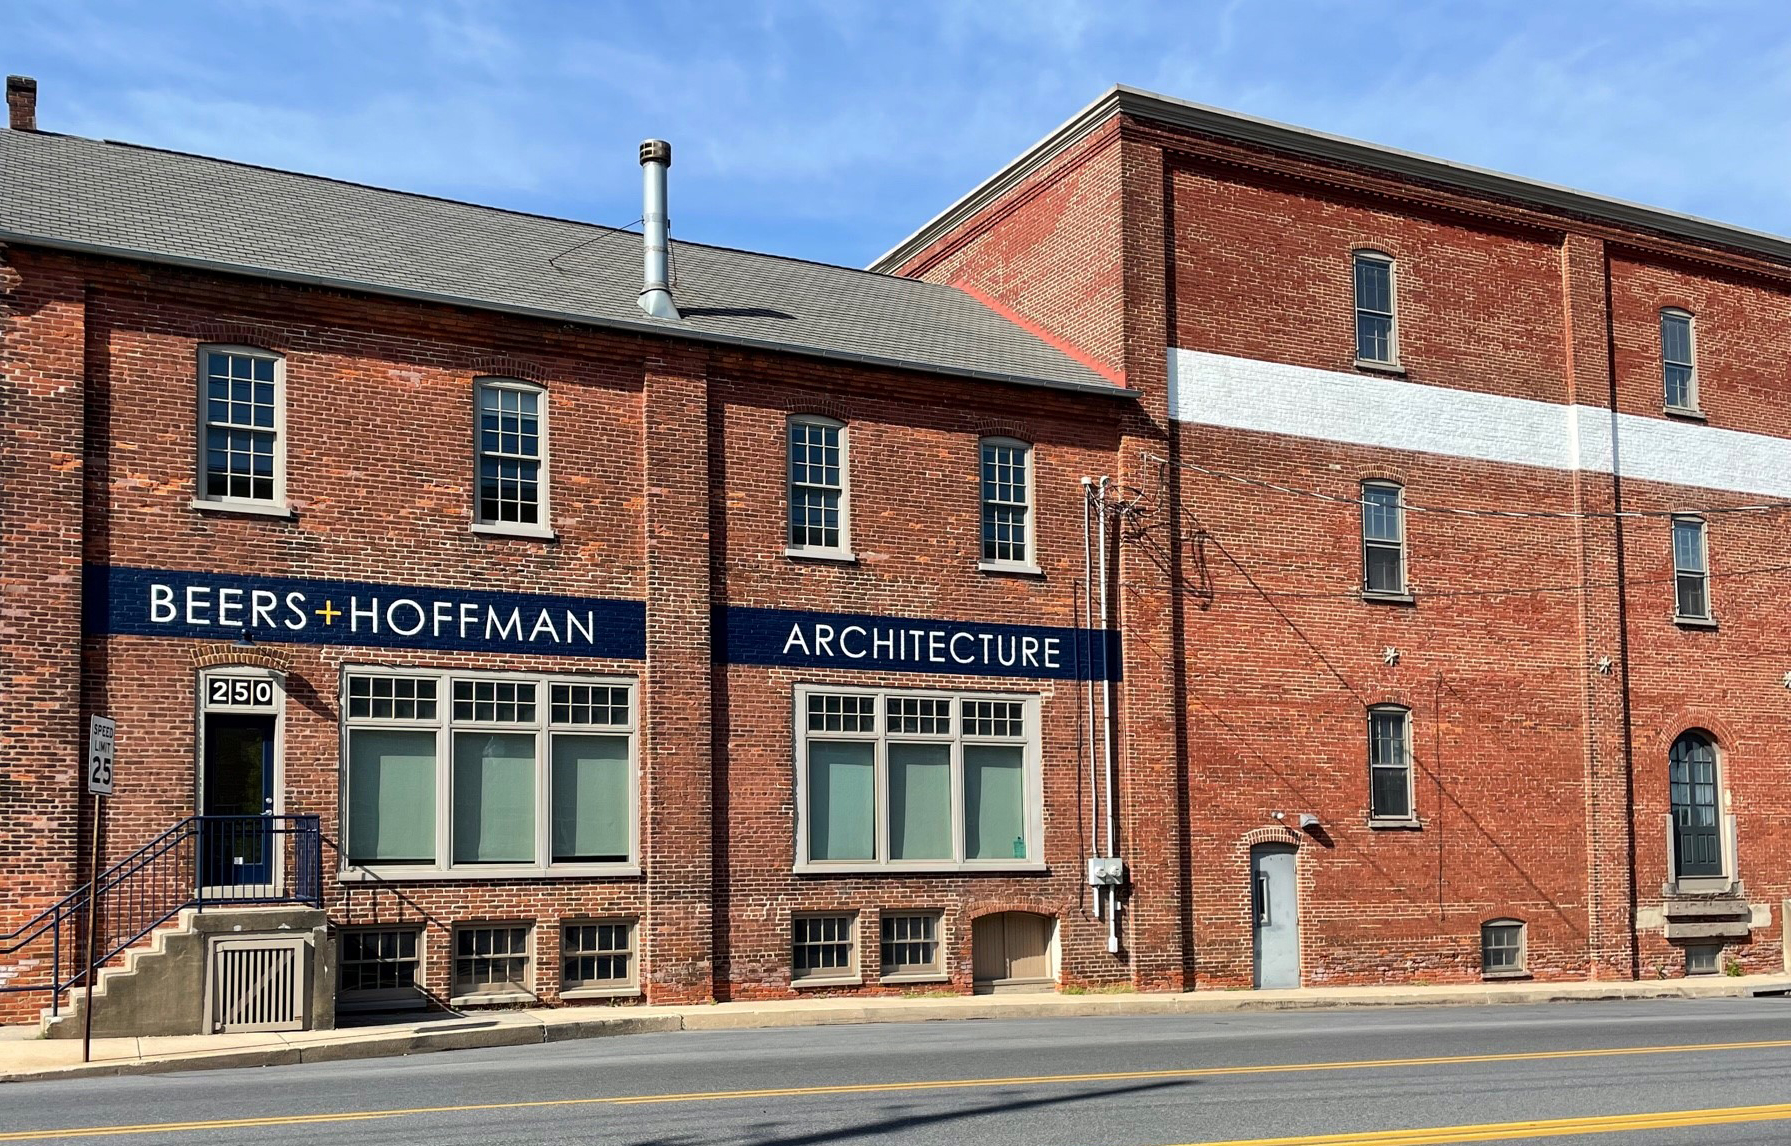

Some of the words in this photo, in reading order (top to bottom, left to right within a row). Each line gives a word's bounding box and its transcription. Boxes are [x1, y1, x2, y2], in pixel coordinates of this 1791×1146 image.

[782, 622, 1061, 668] ARCHITECTURE
[212, 681, 271, 702] 250
[93, 723, 113, 738] SPEED
[94, 740, 111, 753] LIMIT
[92, 755, 111, 785] 25
